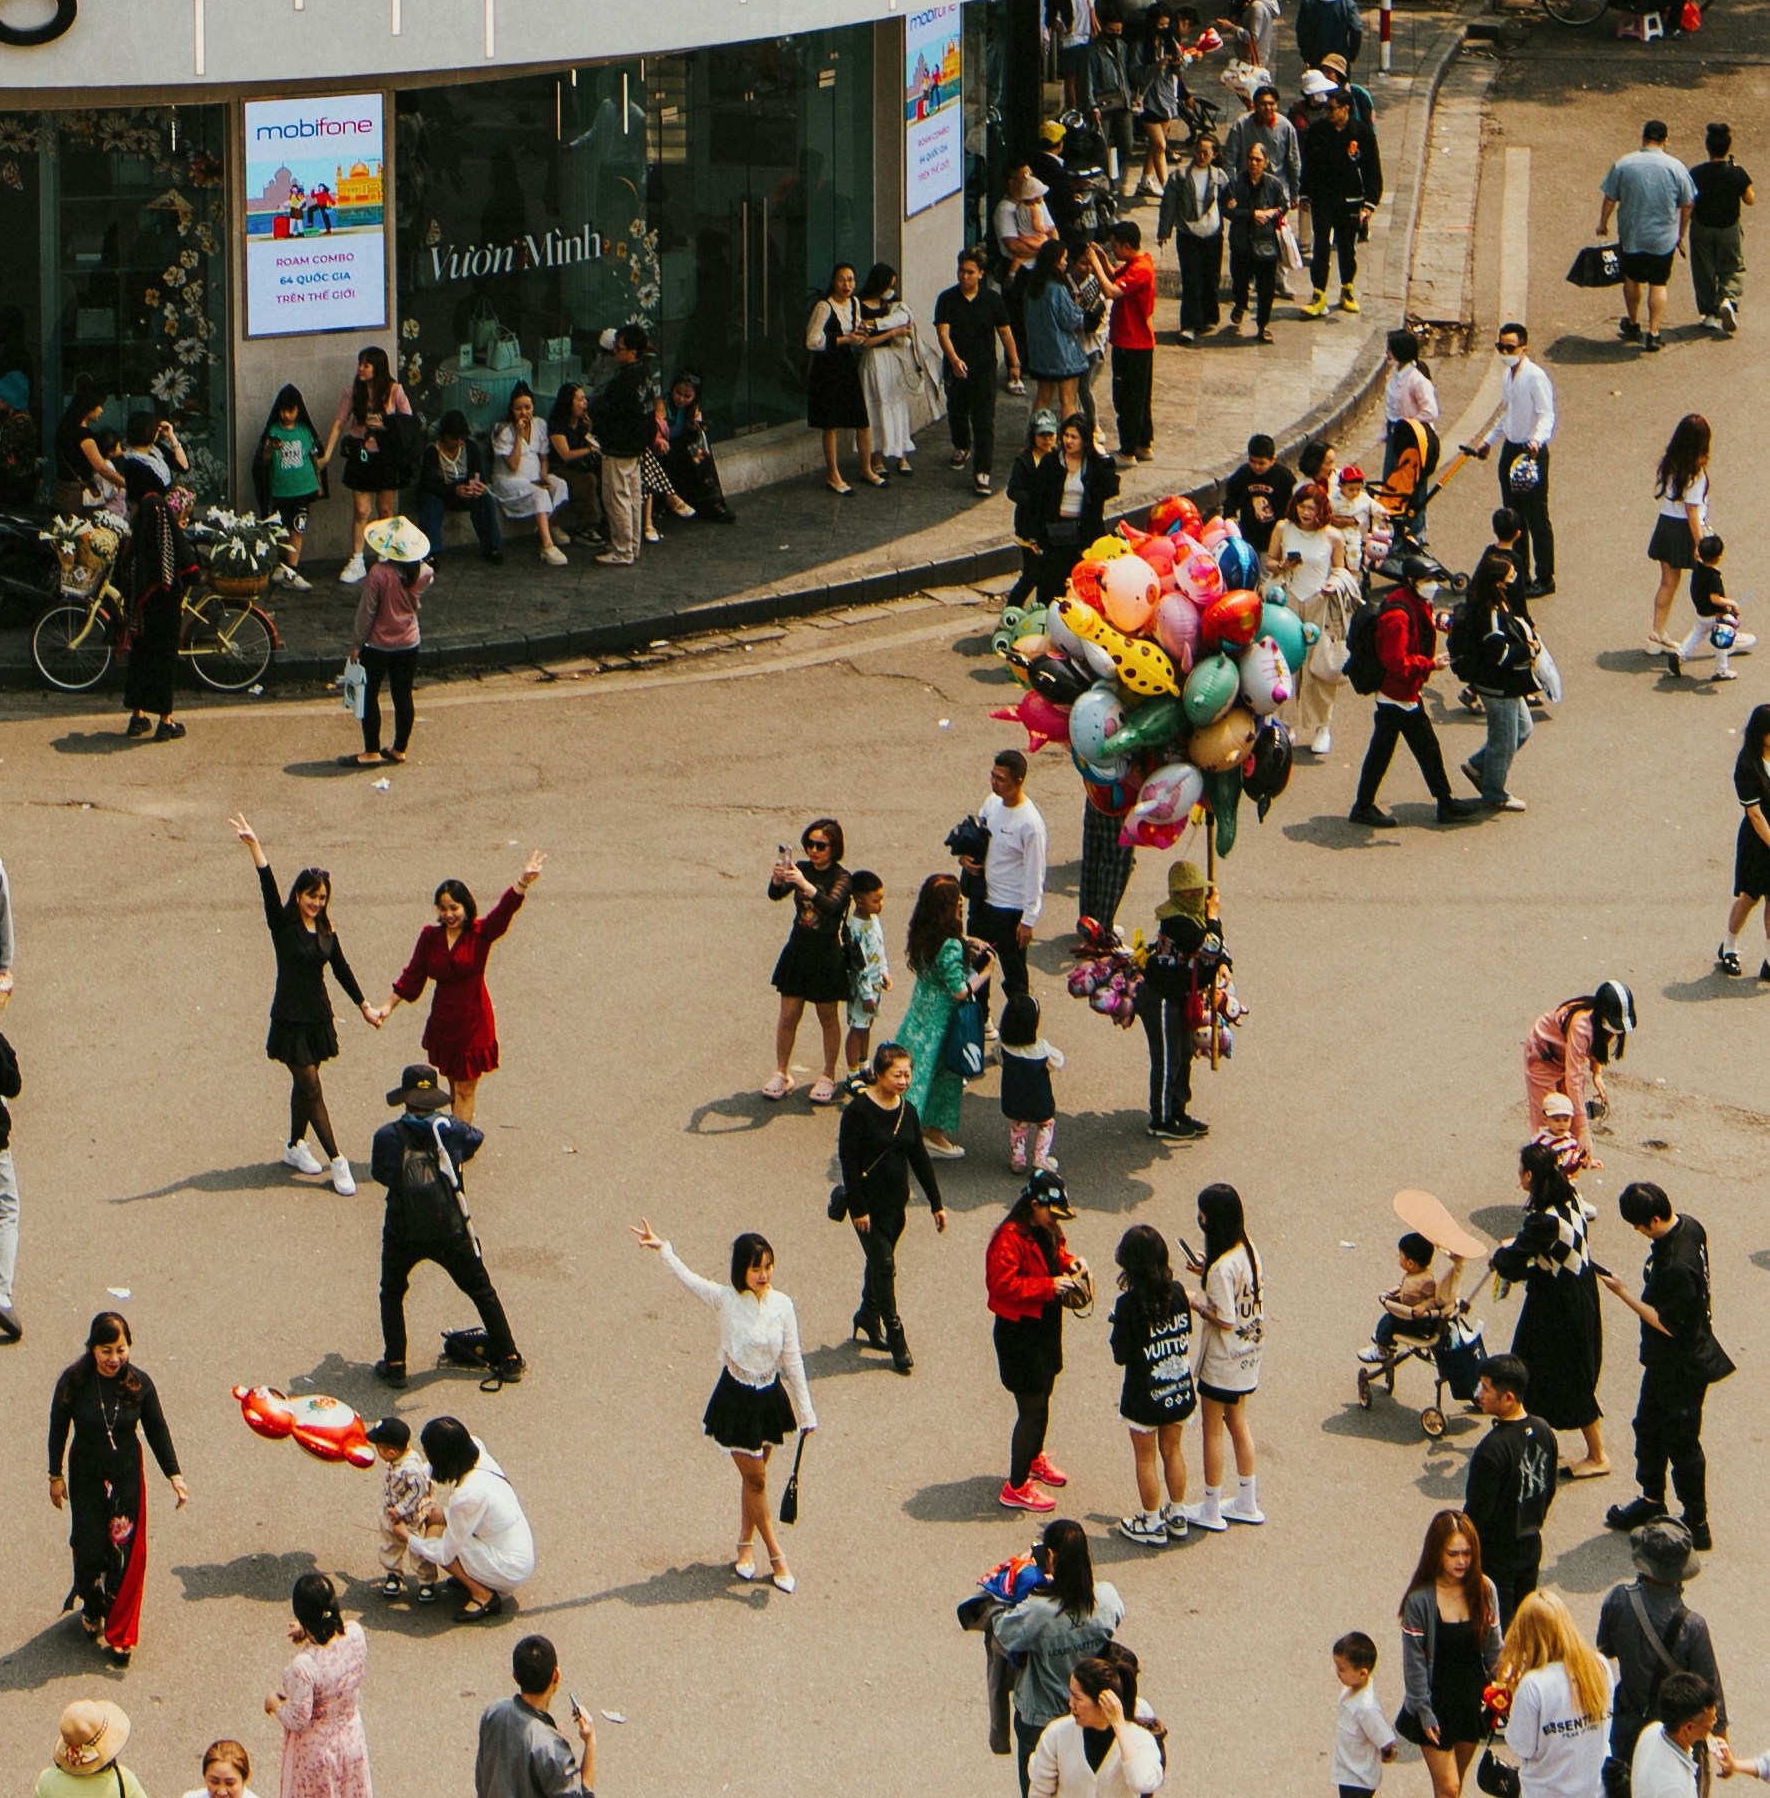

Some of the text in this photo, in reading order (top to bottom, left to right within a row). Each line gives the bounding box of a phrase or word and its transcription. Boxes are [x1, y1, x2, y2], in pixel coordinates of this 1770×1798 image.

[257, 117, 373, 140] mobifone
[276, 252, 355, 267] ROAM COMBO
[431, 223, 602, 281] Vươn Mình
[280, 276, 294, 285] 64
[332, 273, 351, 282] GIA
[276, 292, 305, 304] TRÊN
